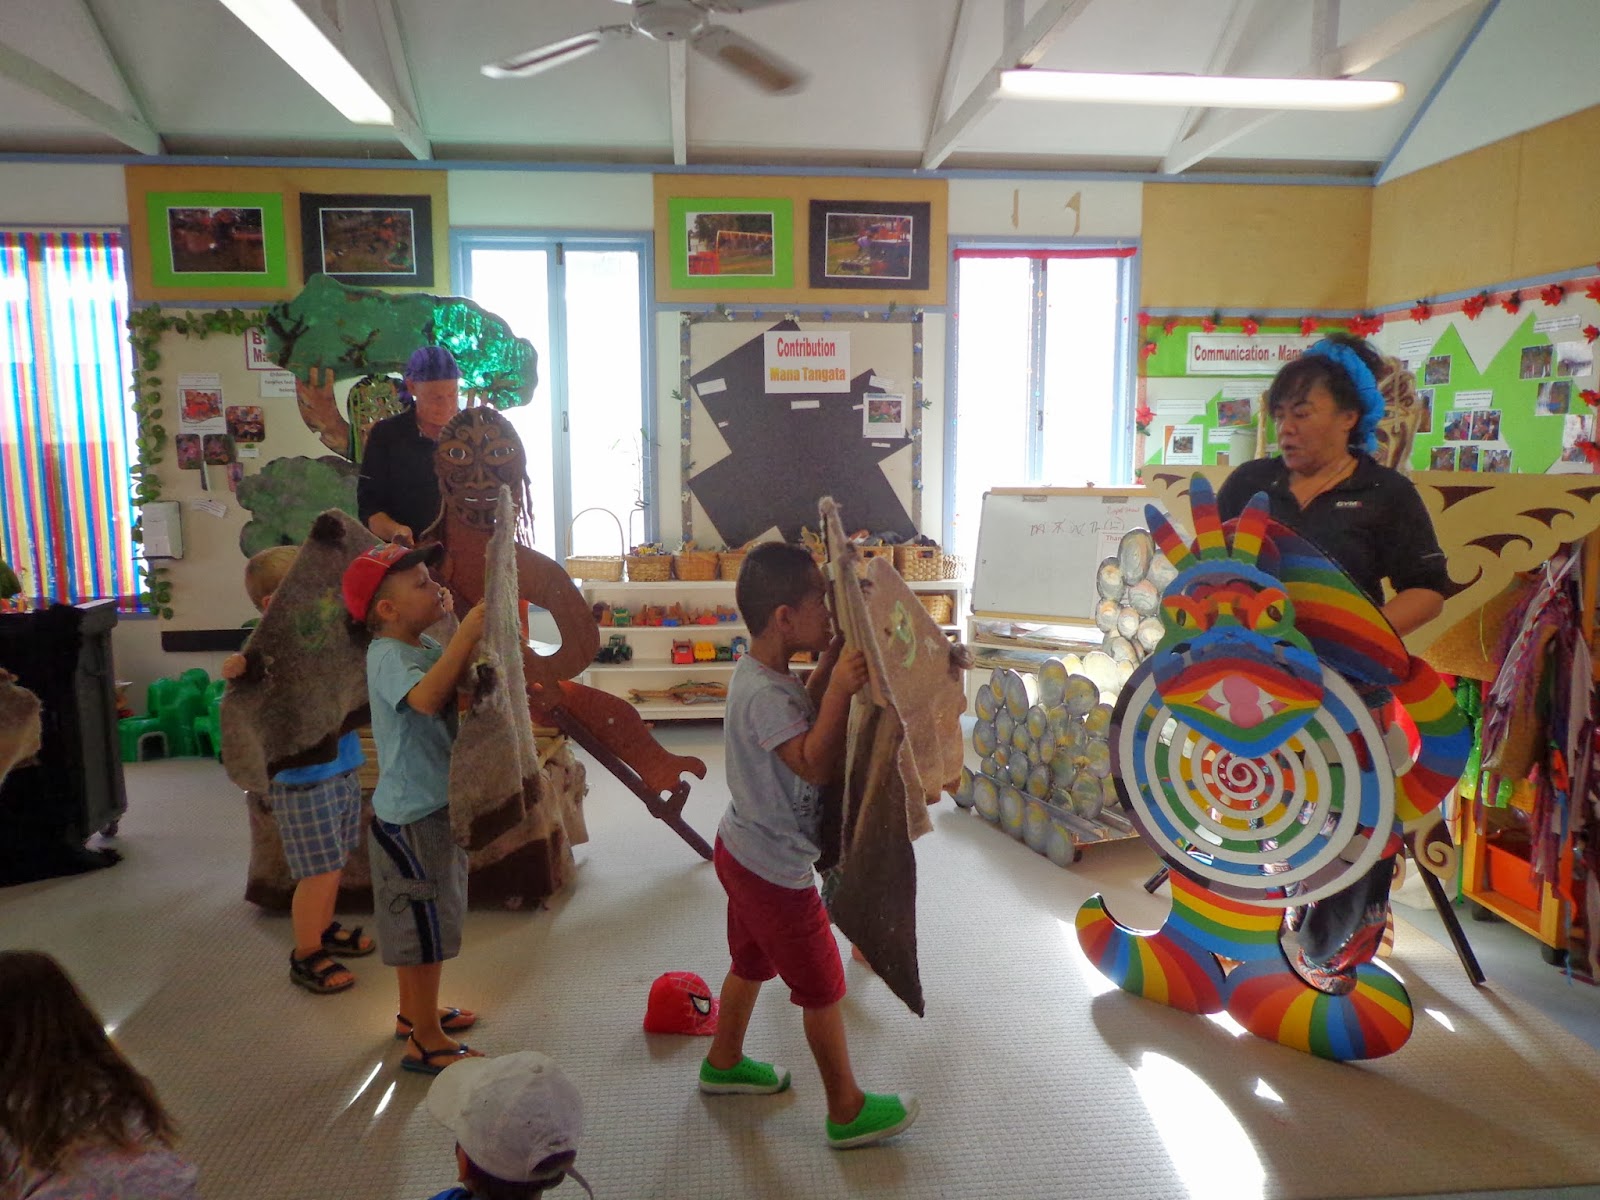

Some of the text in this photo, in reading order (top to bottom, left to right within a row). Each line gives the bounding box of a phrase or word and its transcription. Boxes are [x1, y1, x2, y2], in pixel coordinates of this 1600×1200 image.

[777, 337, 836, 357] Contribution
[1194, 344, 1269, 361] Communication
[770, 367, 846, 382] Mana Tangata
